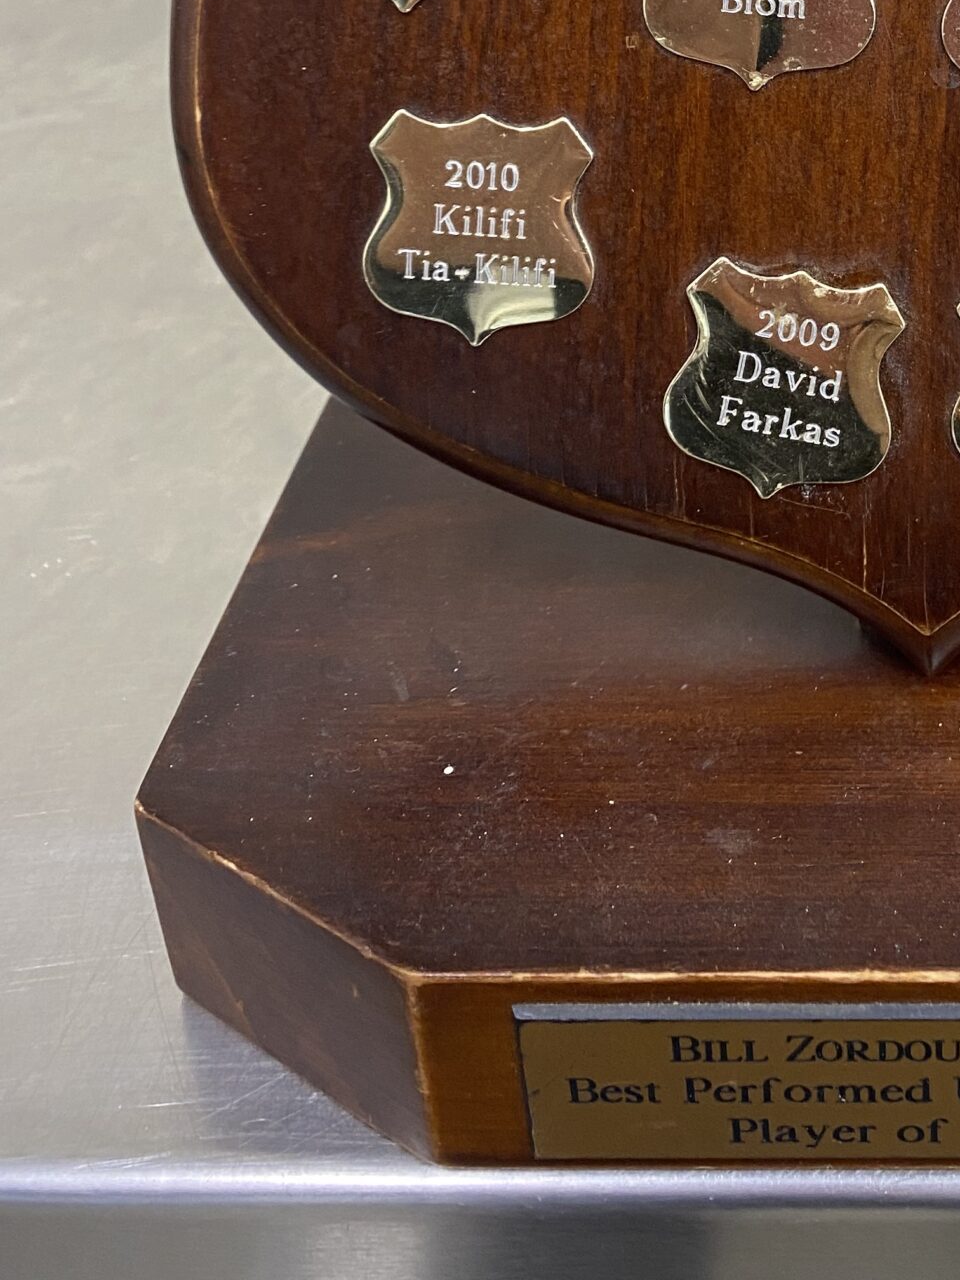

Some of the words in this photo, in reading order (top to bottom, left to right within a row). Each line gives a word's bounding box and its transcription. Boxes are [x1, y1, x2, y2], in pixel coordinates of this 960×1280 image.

[445, 160, 519, 192] 2010
[433, 203, 526, 240] Kilifi
[755, 309, 840, 351] 2009
[733, 350, 842, 402] David
[716, 394, 841, 447] Farkas
[669, 1035, 769, 1063] BILL
[566, 1077, 661, 1105] Best
[684, 1077, 933, 1105] Performed
[728, 1117, 877, 1148] Player
[896, 1118, 949, 1144] of
